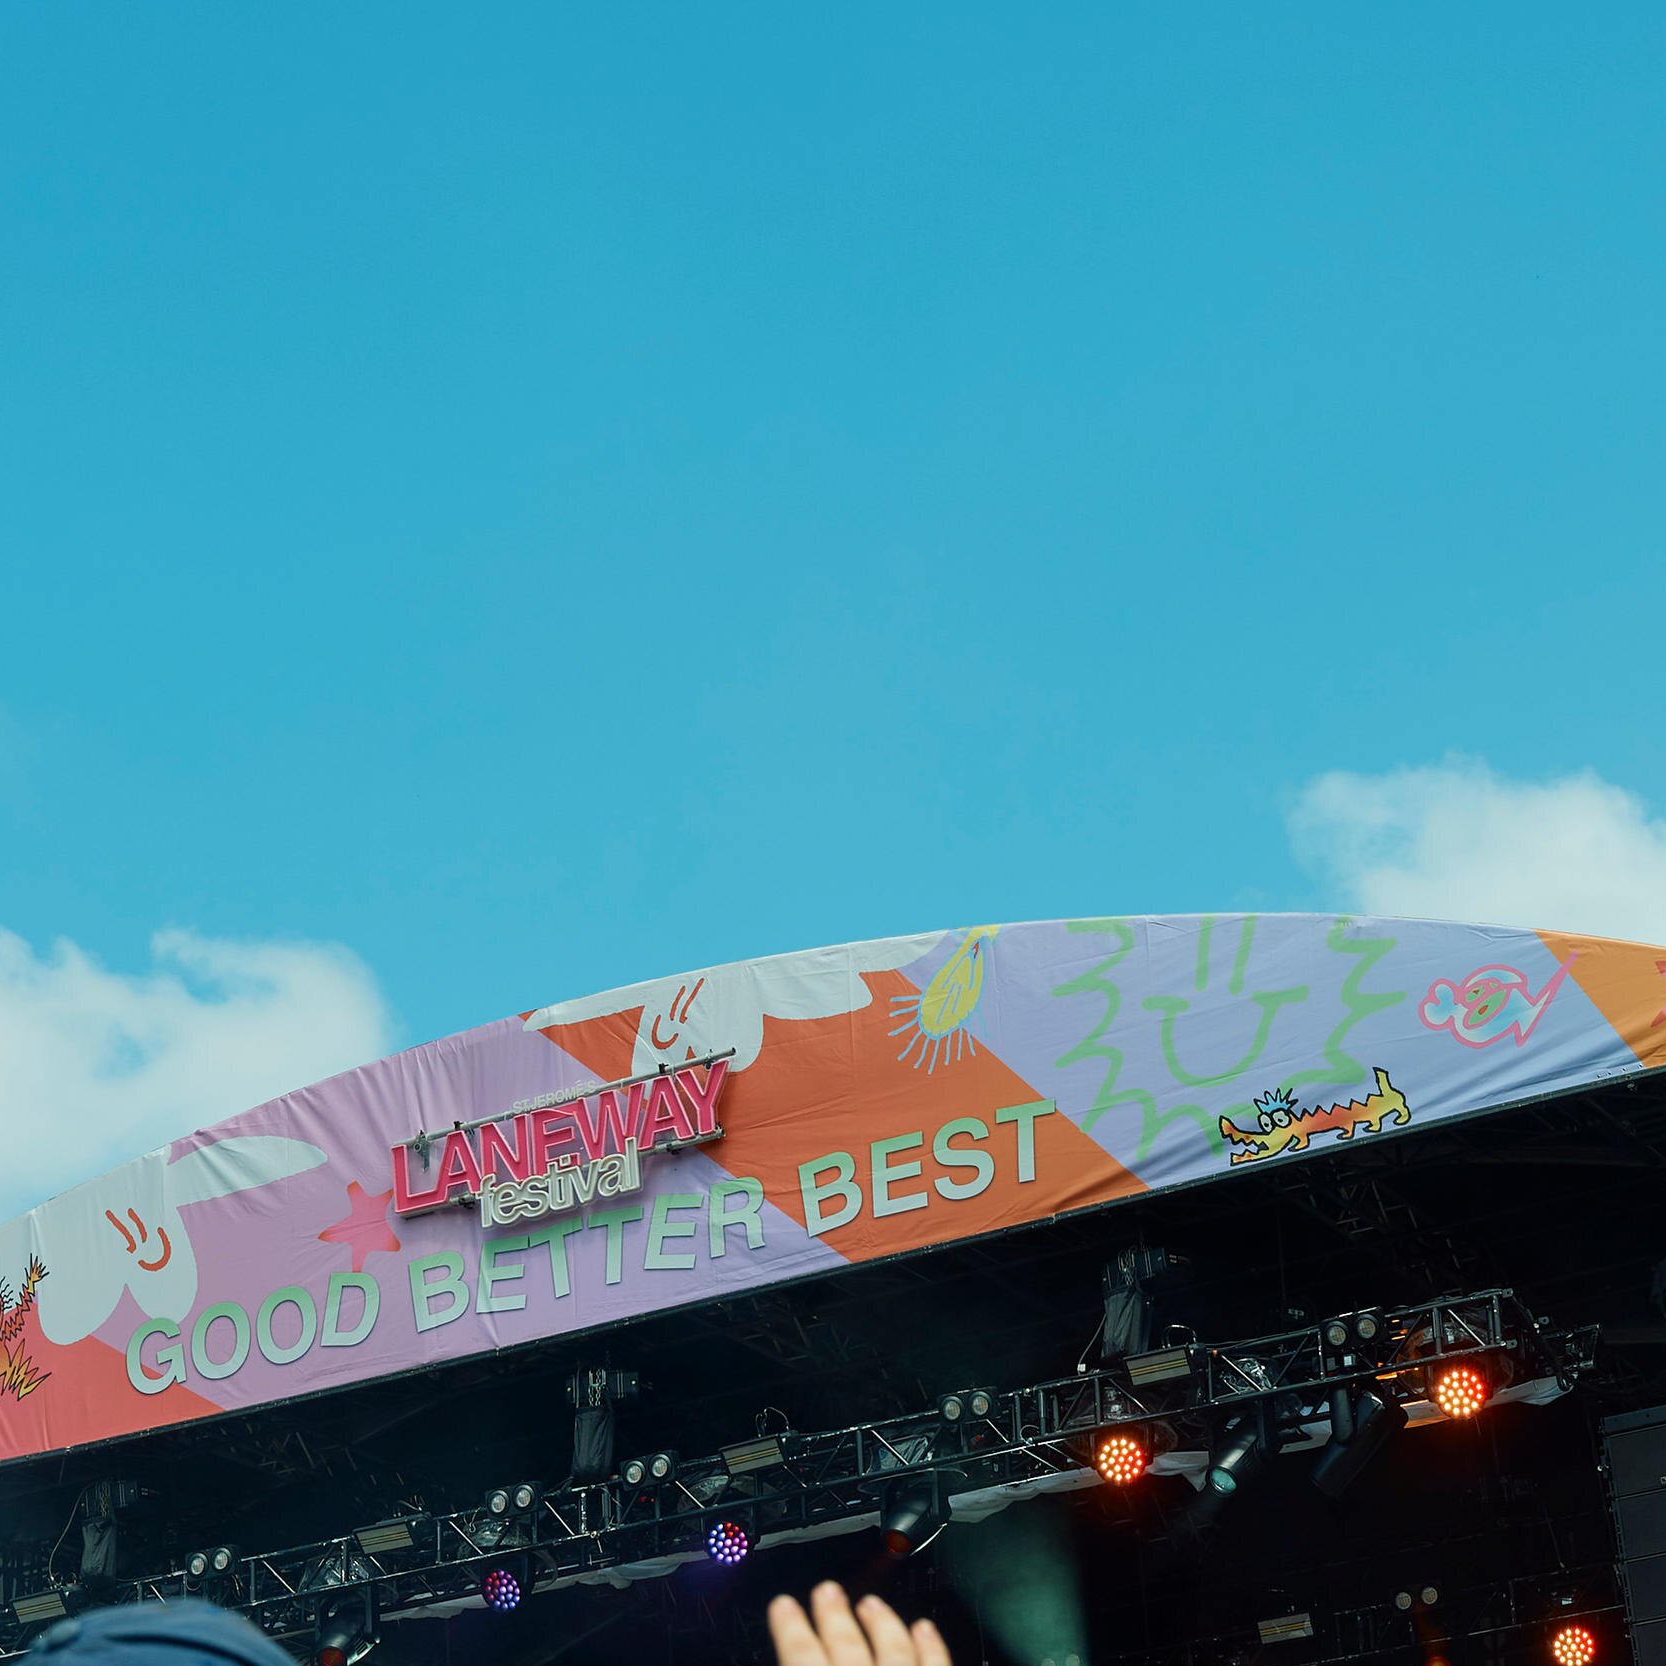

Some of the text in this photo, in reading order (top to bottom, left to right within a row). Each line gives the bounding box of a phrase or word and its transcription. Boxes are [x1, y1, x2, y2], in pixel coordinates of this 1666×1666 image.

[391, 1059, 730, 1215] LANEWAY
[477, 1136, 643, 1229] festival
[126, 1098, 1056, 1395] GOOD BETTER BEST
